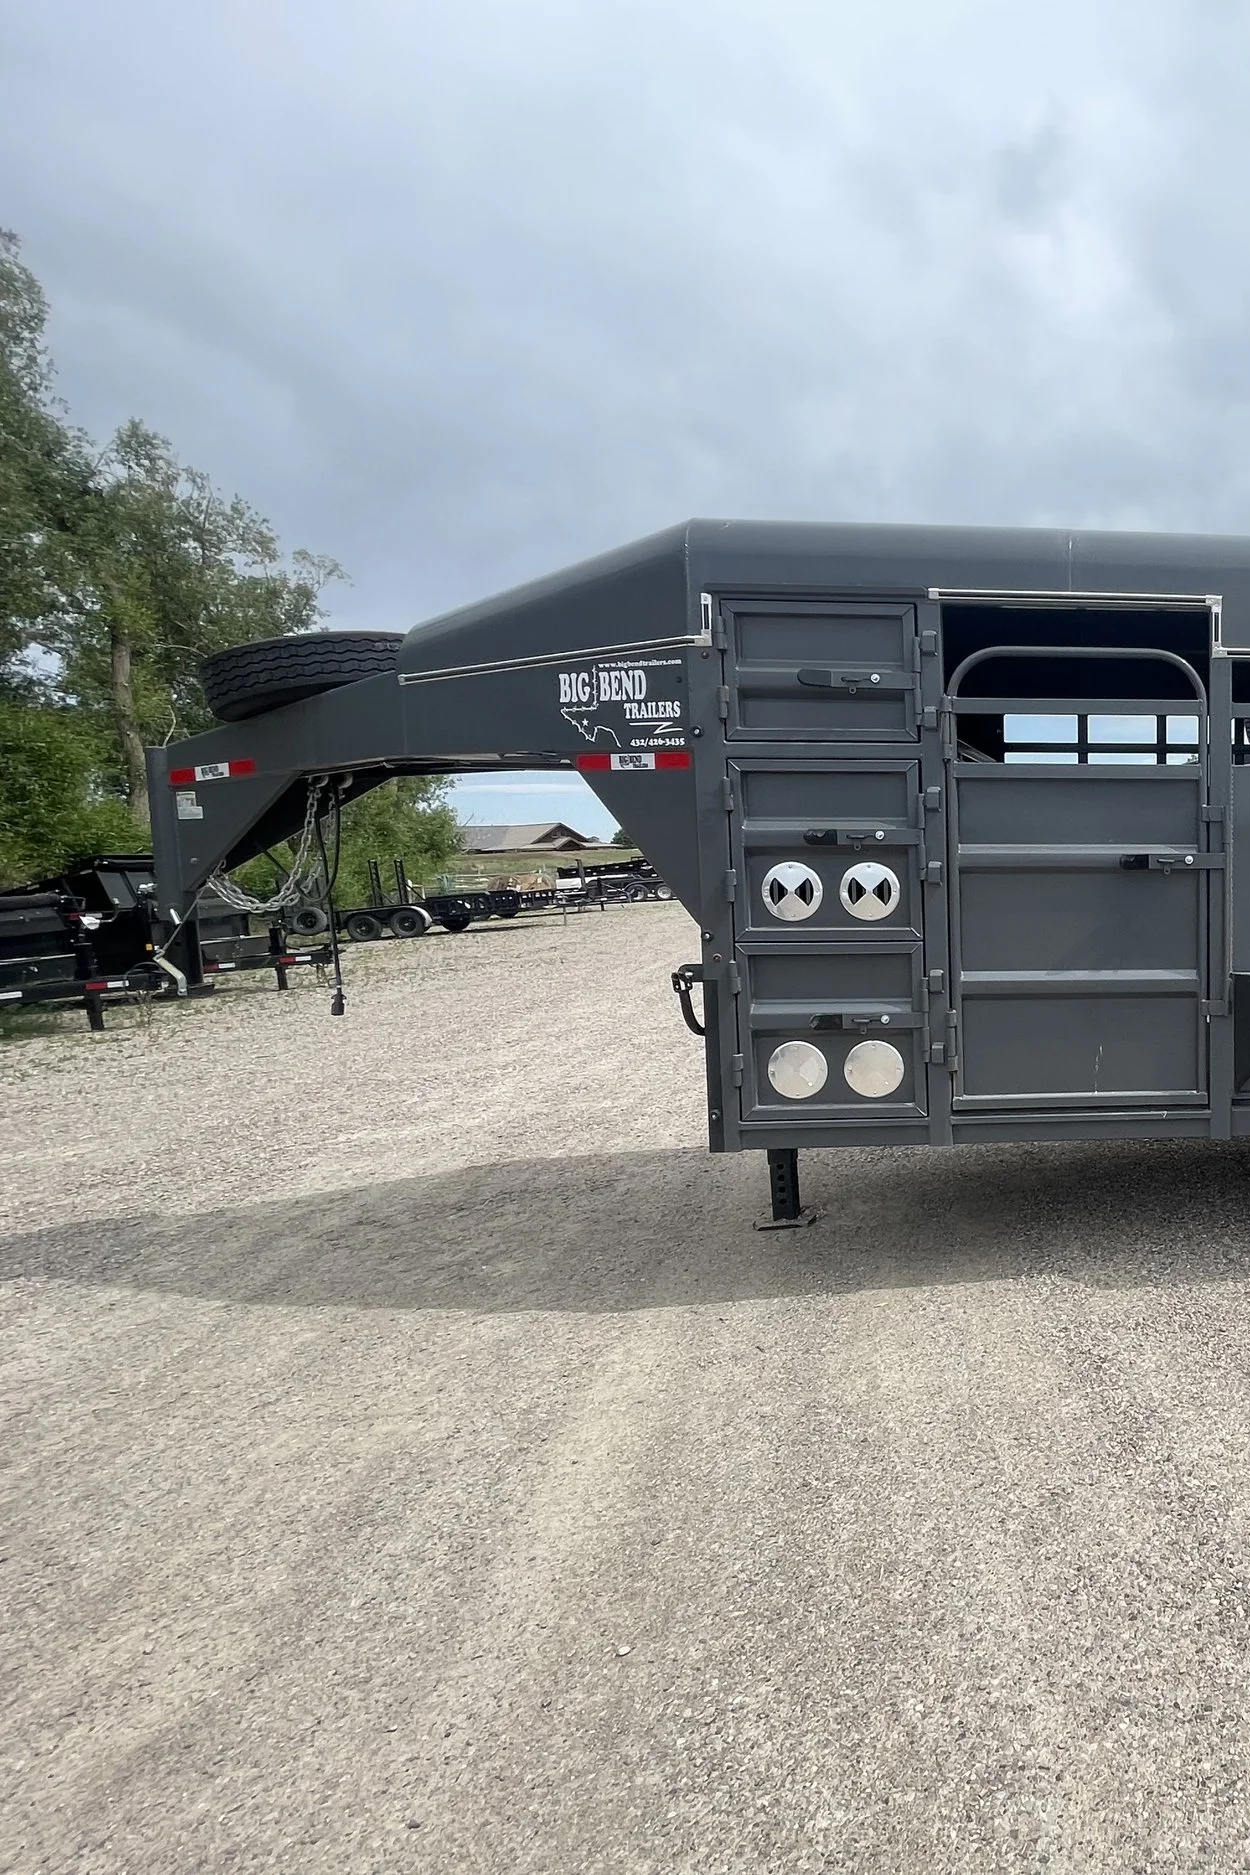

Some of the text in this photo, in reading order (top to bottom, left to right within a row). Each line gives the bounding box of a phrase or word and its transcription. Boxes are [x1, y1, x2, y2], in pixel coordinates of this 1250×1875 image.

[598, 659, 682, 668] www.bigbendtrailers.com
[559, 669, 647, 703] BIG BEND
[623, 701, 681, 719] TRAILERS
